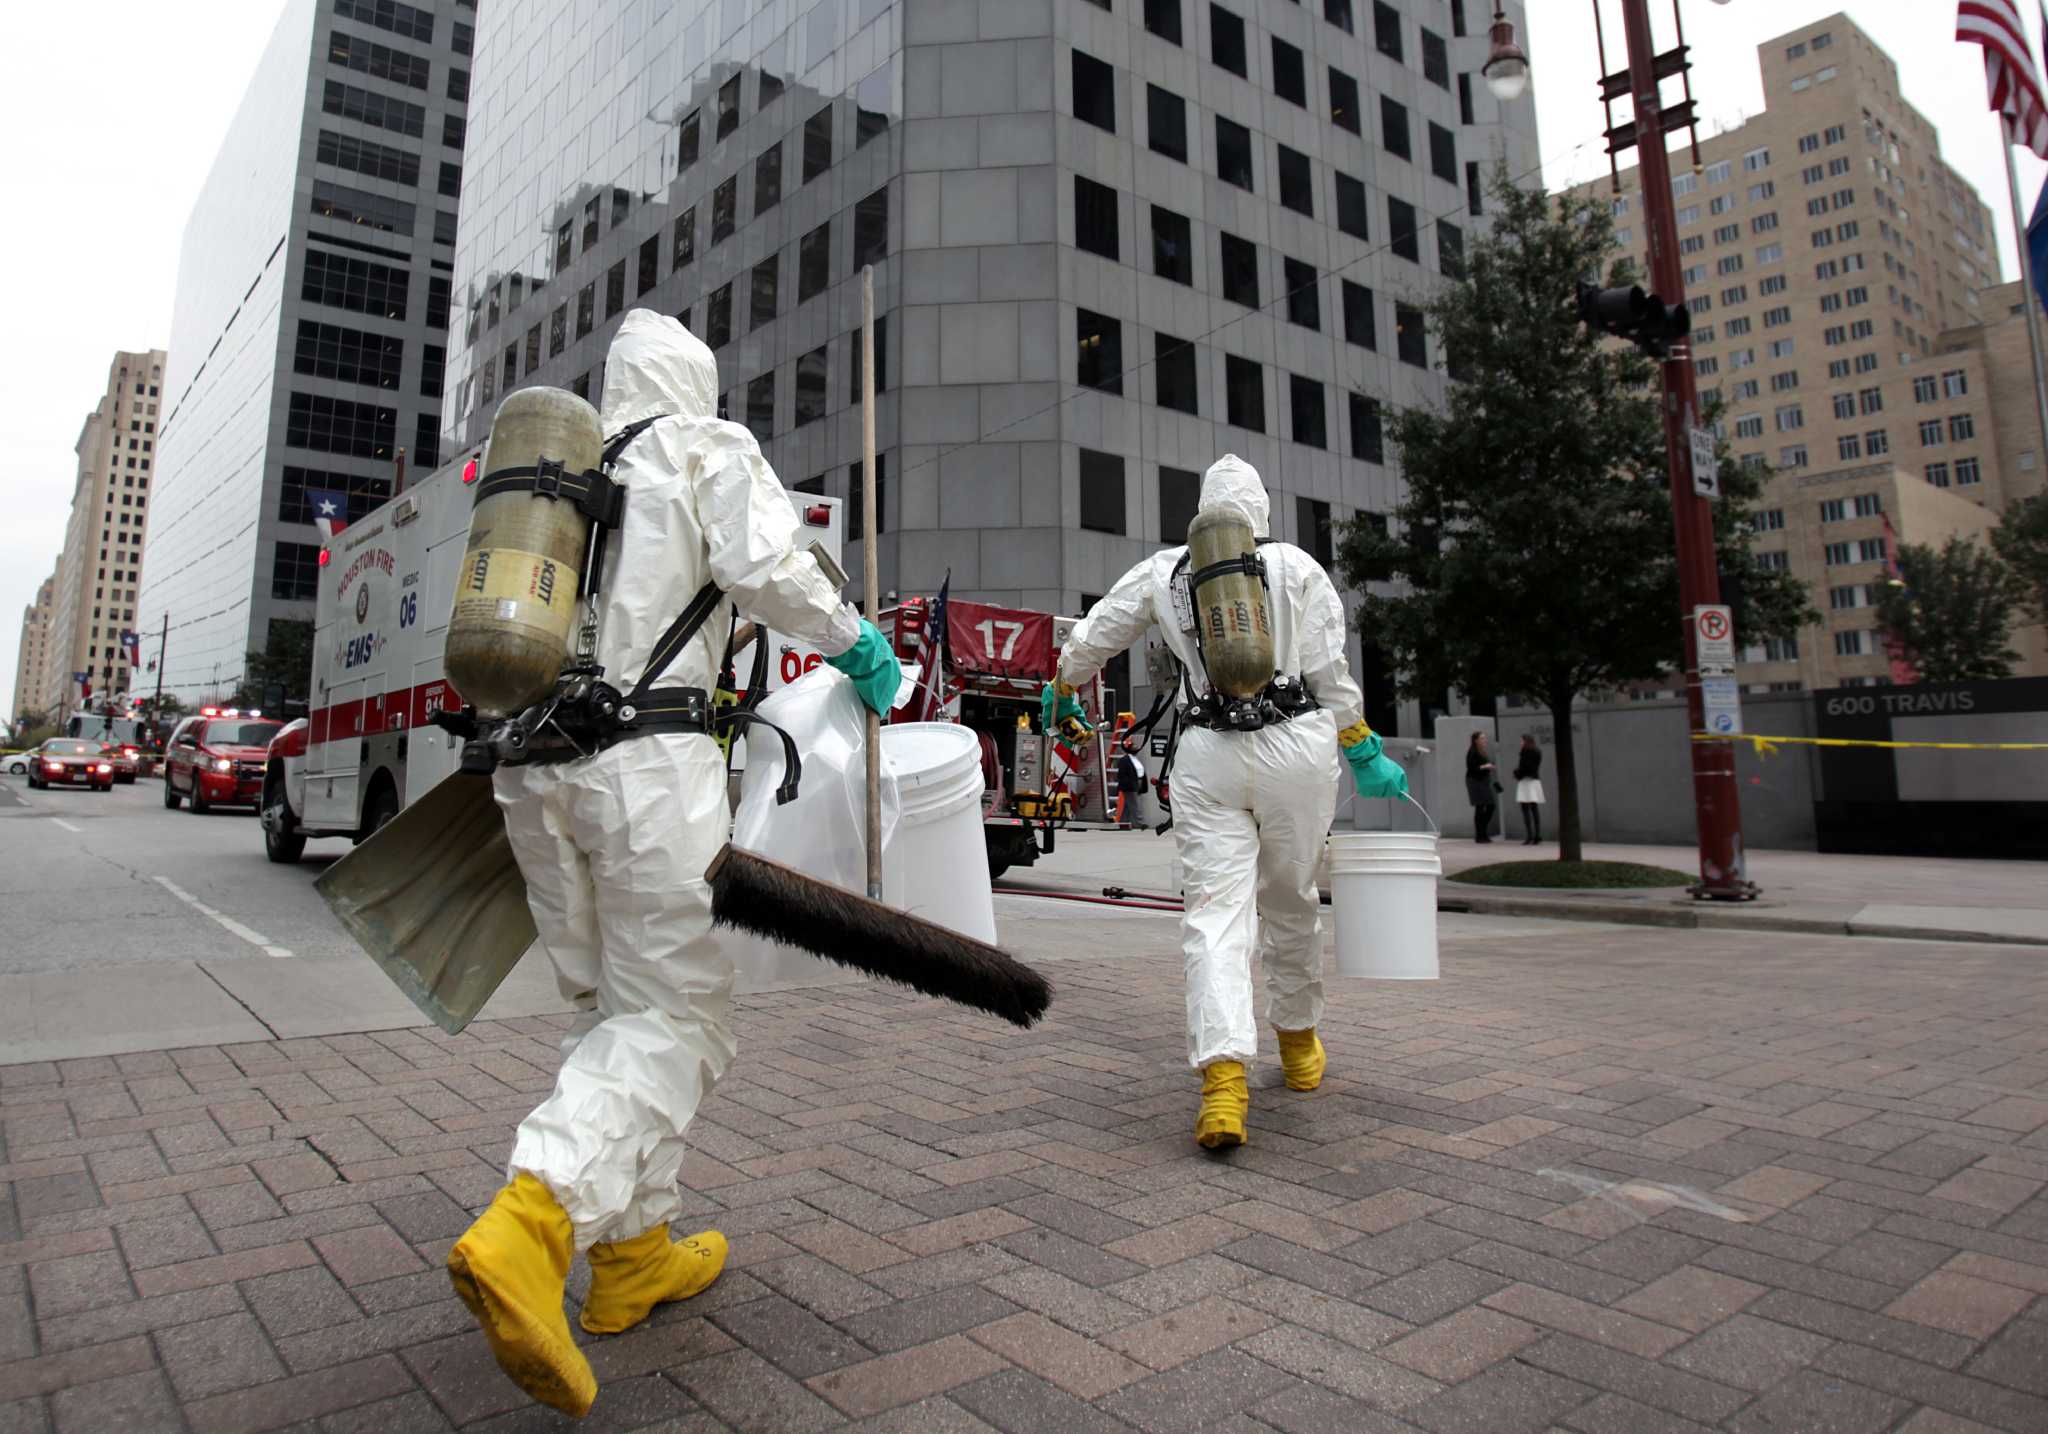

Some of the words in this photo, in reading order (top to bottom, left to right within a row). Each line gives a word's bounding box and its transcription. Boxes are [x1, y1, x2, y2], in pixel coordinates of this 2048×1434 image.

[338, 548, 375, 601] HOUSTON
[376, 548, 396, 577] FIRE
[472, 550, 490, 593] SCOTT
[537, 558, 556, 606] SCOTT
[400, 592, 417, 629] 06
[1210, 606, 1226, 640] SCOTT
[1234, 600, 1251, 635] SCOTT
[346, 633, 373, 669] EMS
[975, 618, 1025, 661] 17
[1826, 696, 1875, 716] 600
[1881, 690, 1975, 712] TRAVIS
